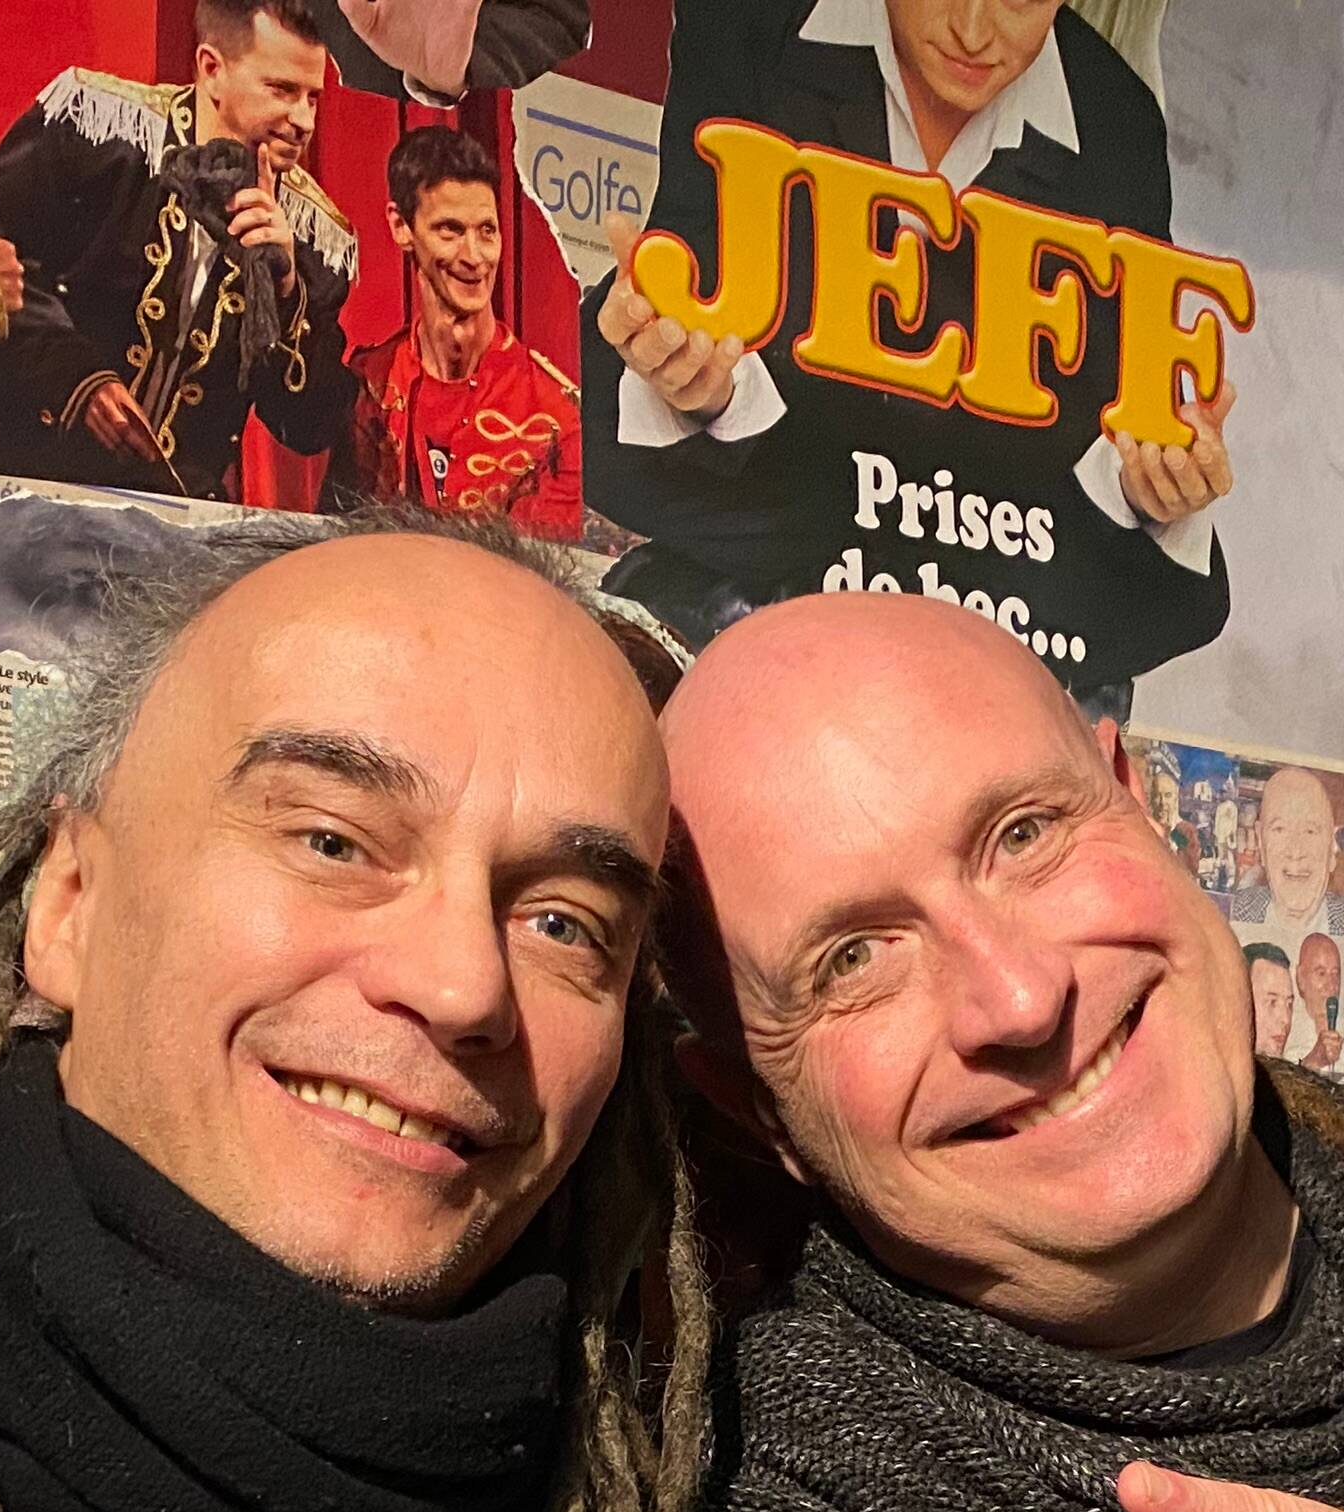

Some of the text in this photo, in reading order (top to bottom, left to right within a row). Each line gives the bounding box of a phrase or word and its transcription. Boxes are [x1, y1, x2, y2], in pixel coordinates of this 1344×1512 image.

[630, 117, 1256, 448] JEFF
[852, 449, 1057, 563] Prises
[17, 669, 49, 686] style
